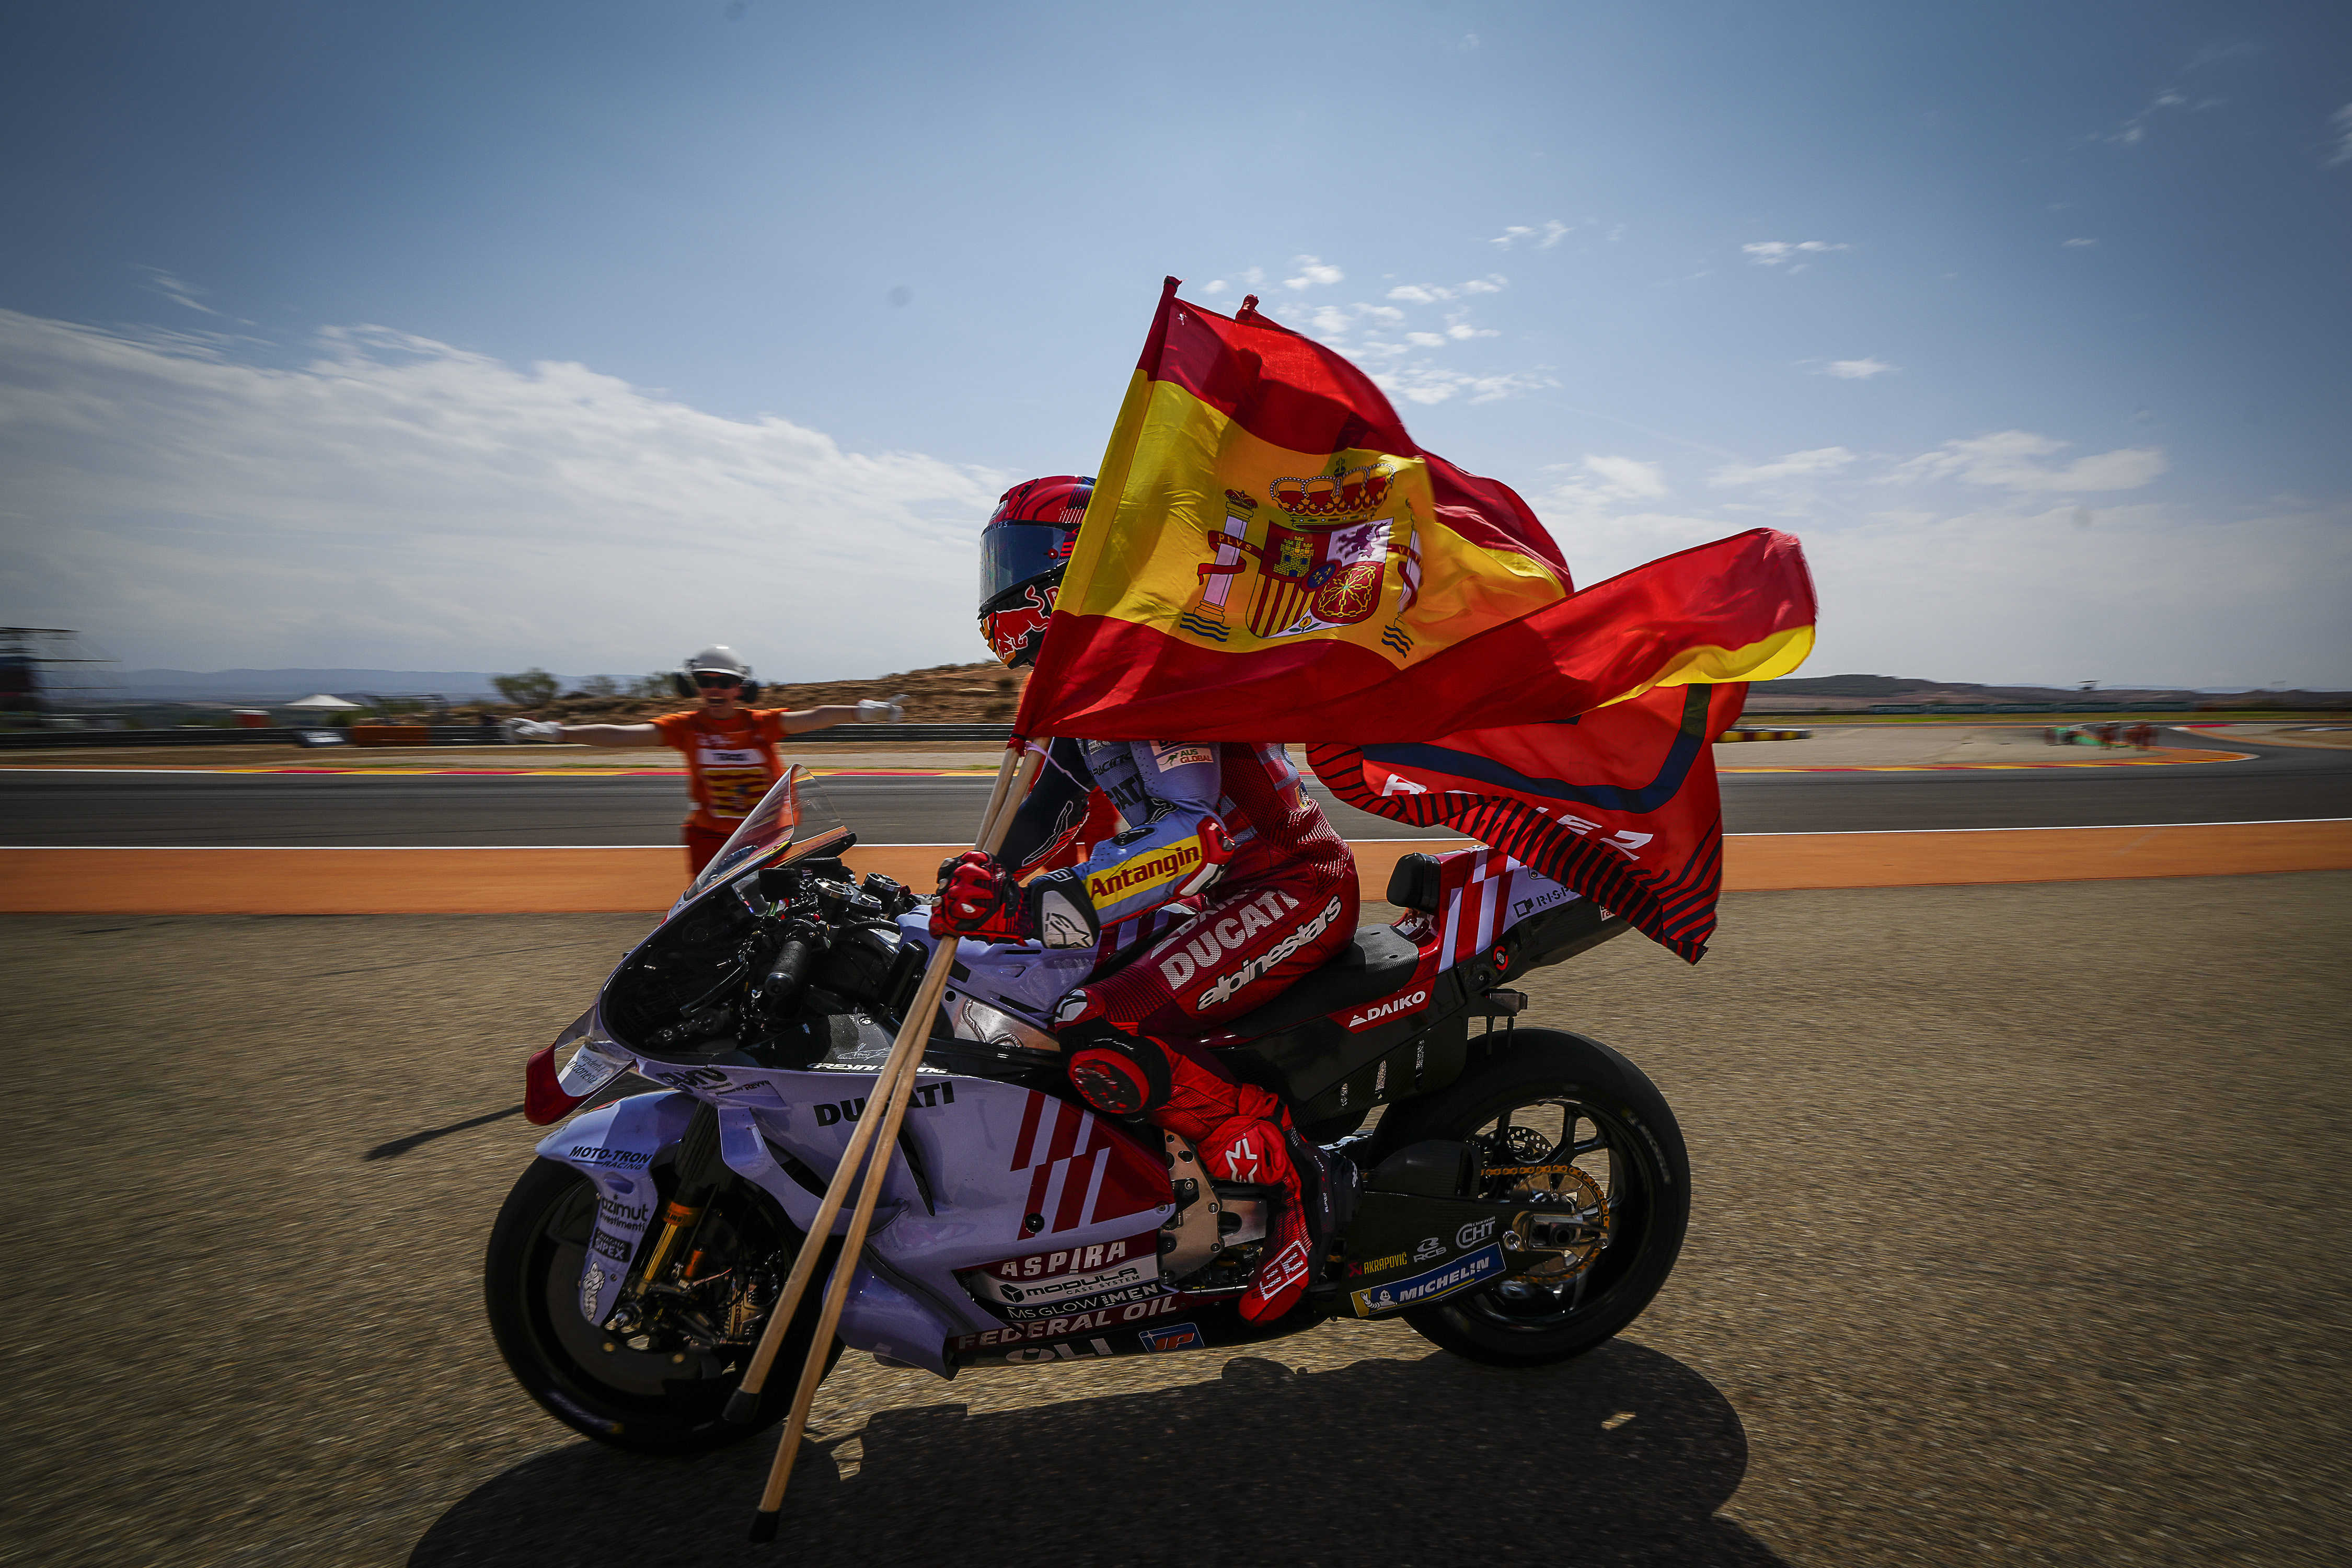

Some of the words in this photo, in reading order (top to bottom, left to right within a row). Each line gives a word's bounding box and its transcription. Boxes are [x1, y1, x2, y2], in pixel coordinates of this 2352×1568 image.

[1218, 534, 1252, 551] PLVS
[1180, 755, 1213, 763] GLOBAL
[1181, 748, 1198, 757] AUS
[1091, 846, 1200, 901] Antangin
[1159, 889, 1300, 990] DUCATI
[1197, 896, 1342, 1010] alpinestars
[1367, 990, 1426, 1020] DAIKO
[569, 1146, 653, 1164] MOTO-TRON
[601, 1161, 645, 1170] RACING
[1460, 1220, 1495, 1244] CHT
[1001, 1241, 1126, 1277] ASPIRA
[1413, 1246, 1447, 1263] RCB
[1026, 1267, 1138, 1297] MODULA
[1066, 1286, 1094, 1295] CASE
[1099, 1275, 1140, 1288] SYSTEM
[1400, 1256, 1490, 1302] MICHELIN
[1007, 1307, 1036, 1319] MS
[1039, 1297, 1097, 1316] GLOW
[1101, 1295, 1109, 1305] FOR
[1108, 1284, 1158, 1304] MEN
[958, 1311, 1112, 1350] FEDERAL
[1123, 1296, 1177, 1320] OIL
[1155, 1332, 1194, 1351] IP
